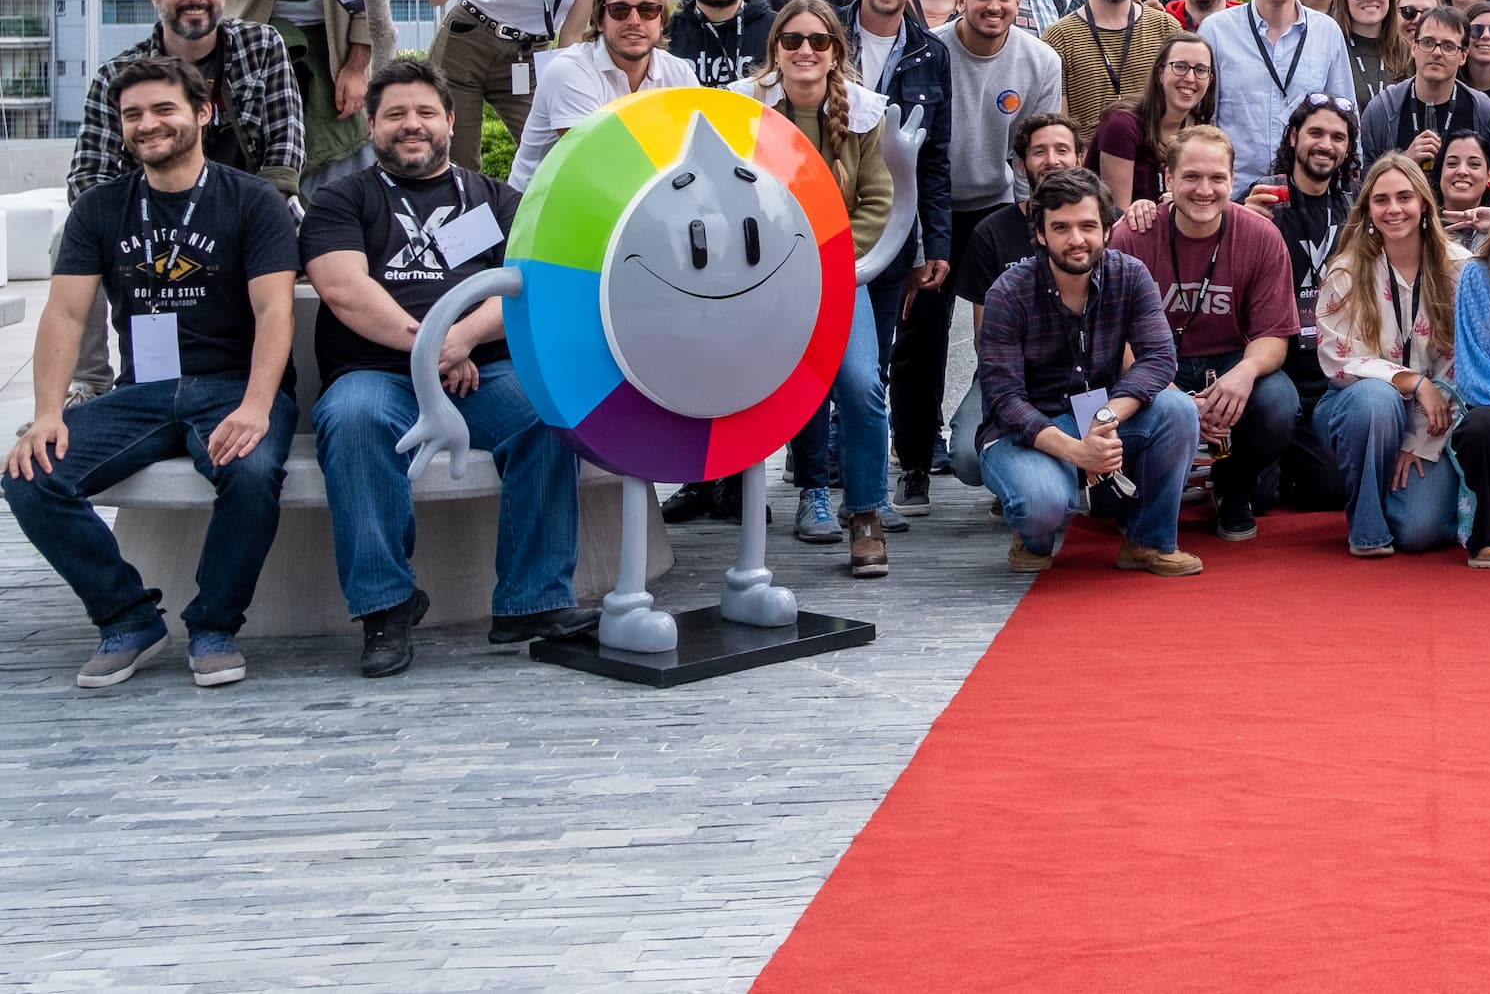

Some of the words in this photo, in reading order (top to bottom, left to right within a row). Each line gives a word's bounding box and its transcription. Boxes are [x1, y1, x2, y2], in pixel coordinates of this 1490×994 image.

[120, 228, 216, 254] CAIFONIA
[384, 269, 444, 280] etermax
[134, 288, 174, 298] GOLEN
[178, 286, 206, 298] STATE
[1151, 282, 1233, 315] VANS
